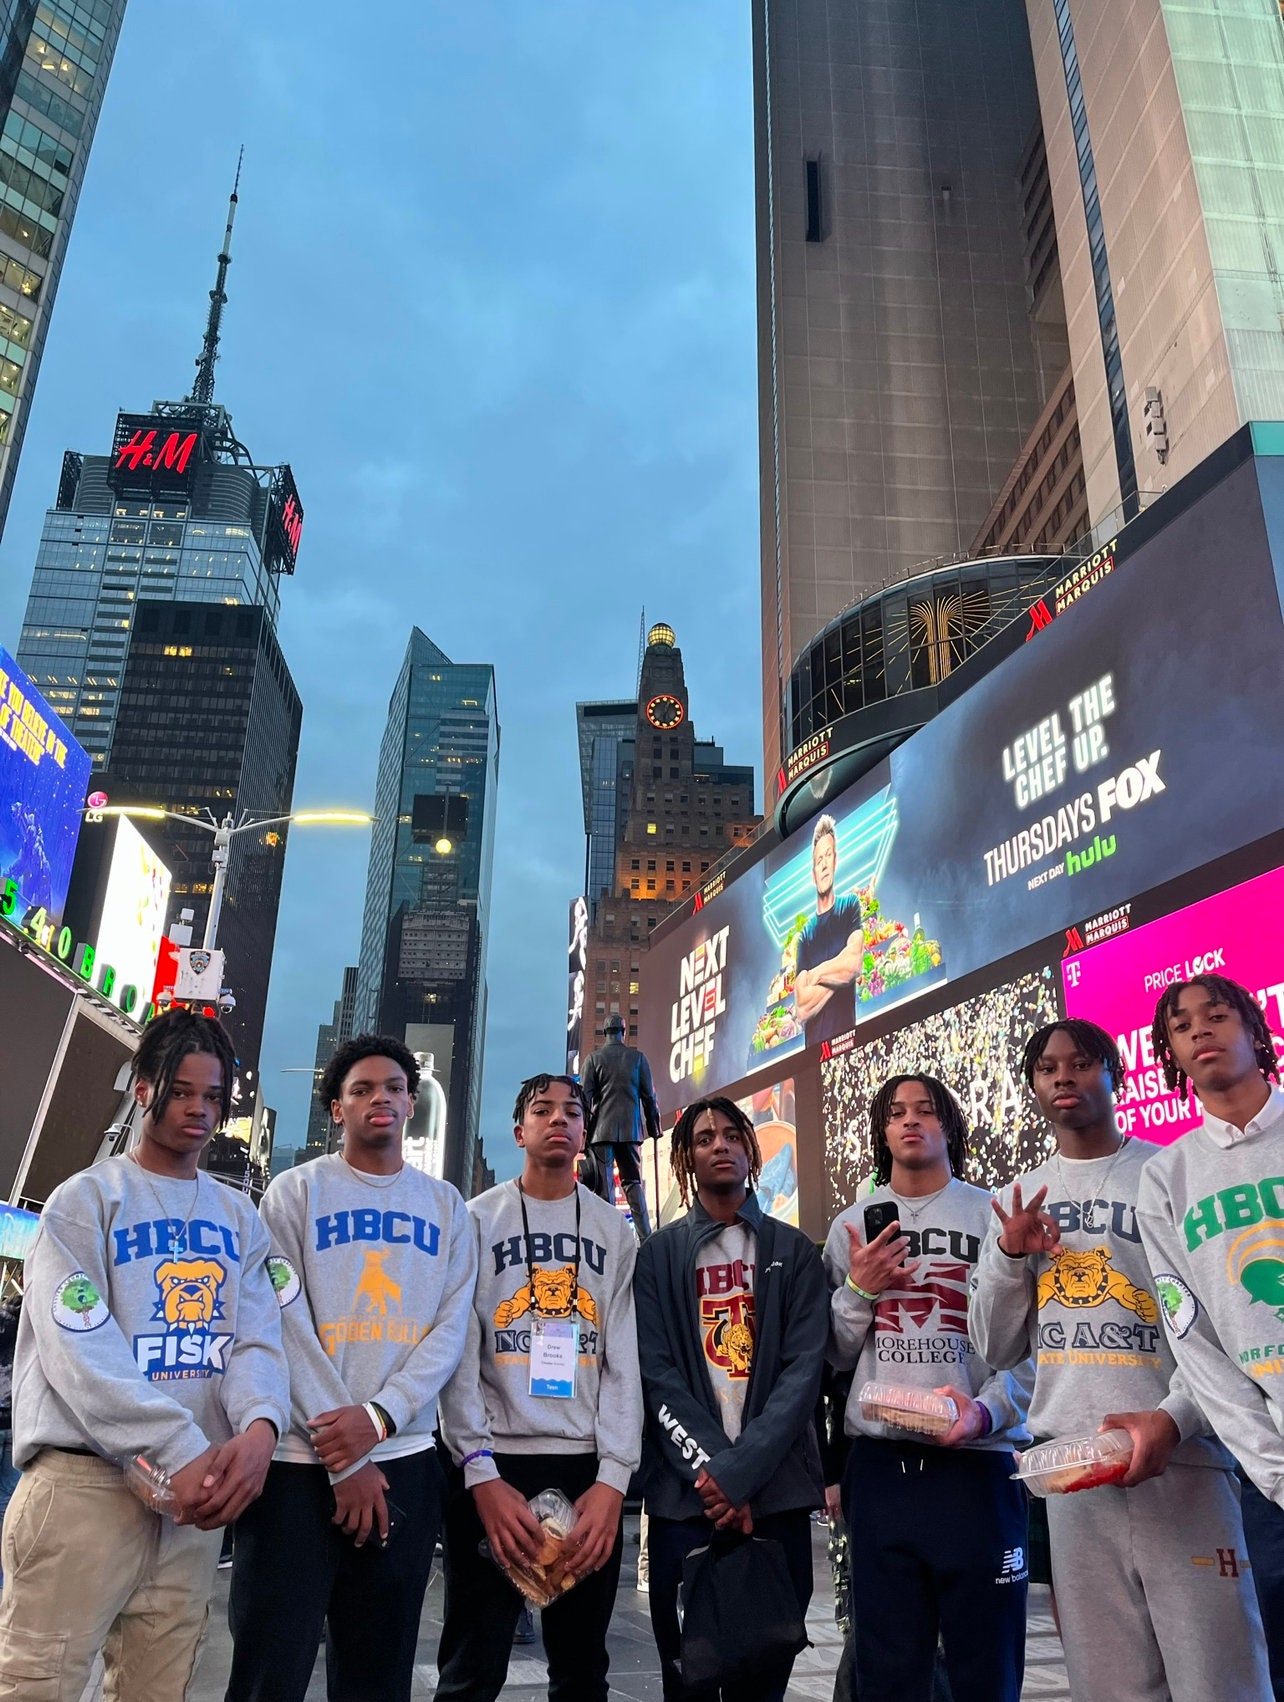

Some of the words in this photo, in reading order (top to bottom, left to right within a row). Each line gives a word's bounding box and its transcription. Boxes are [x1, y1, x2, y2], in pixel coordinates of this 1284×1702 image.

[115, 429, 198, 474] H&M
[1055, 538, 1118, 599] MARRIOTT
[1056, 559, 1113, 614] MARQUIS
[788, 726, 834, 768] MARRIOTT
[1002, 711, 1066, 782] LEVEL
[1068, 672, 1116, 734] THE
[788, 745, 828, 781] MARQUIS
[1014, 745, 1067, 810] CHEF
[1073, 722, 1110, 773] UP.
[85, 812, 103, 823] LG
[984, 791, 1096, 886] THURSDAYS
[1097, 749, 1166, 824] FOX
[1027, 871, 1049, 891] NEXT
[1048, 863, 1065, 880] DAY
[1066, 834, 1118, 877] hulu
[1085, 903, 1132, 932] MARRIOTT
[1086, 917, 1129, 944] MARQUIS
[680, 925, 731, 998] NEXT
[1144, 963, 1183, 993] PRICE
[1184, 947, 1226, 977] LOCK
[670, 976, 727, 1044] LEVEL
[668, 1022, 717, 1084] CHEF
[1139, 1096, 1192, 1129] YOUR
[113, 1218, 240, 1267] HBCU
[315, 1207, 440, 1256] HBCU
[1048, 1198, 1142, 1244] BCU
[492, 1232, 607, 1276] HBCU
[900, 1227, 980, 1264] BCU
[137, 1334, 233, 1372] FISK
[1072, 1322, 1160, 1352] A&T
[658, 1403, 713, 1469] WEST
[995, 1576, 1010, 1584] new
